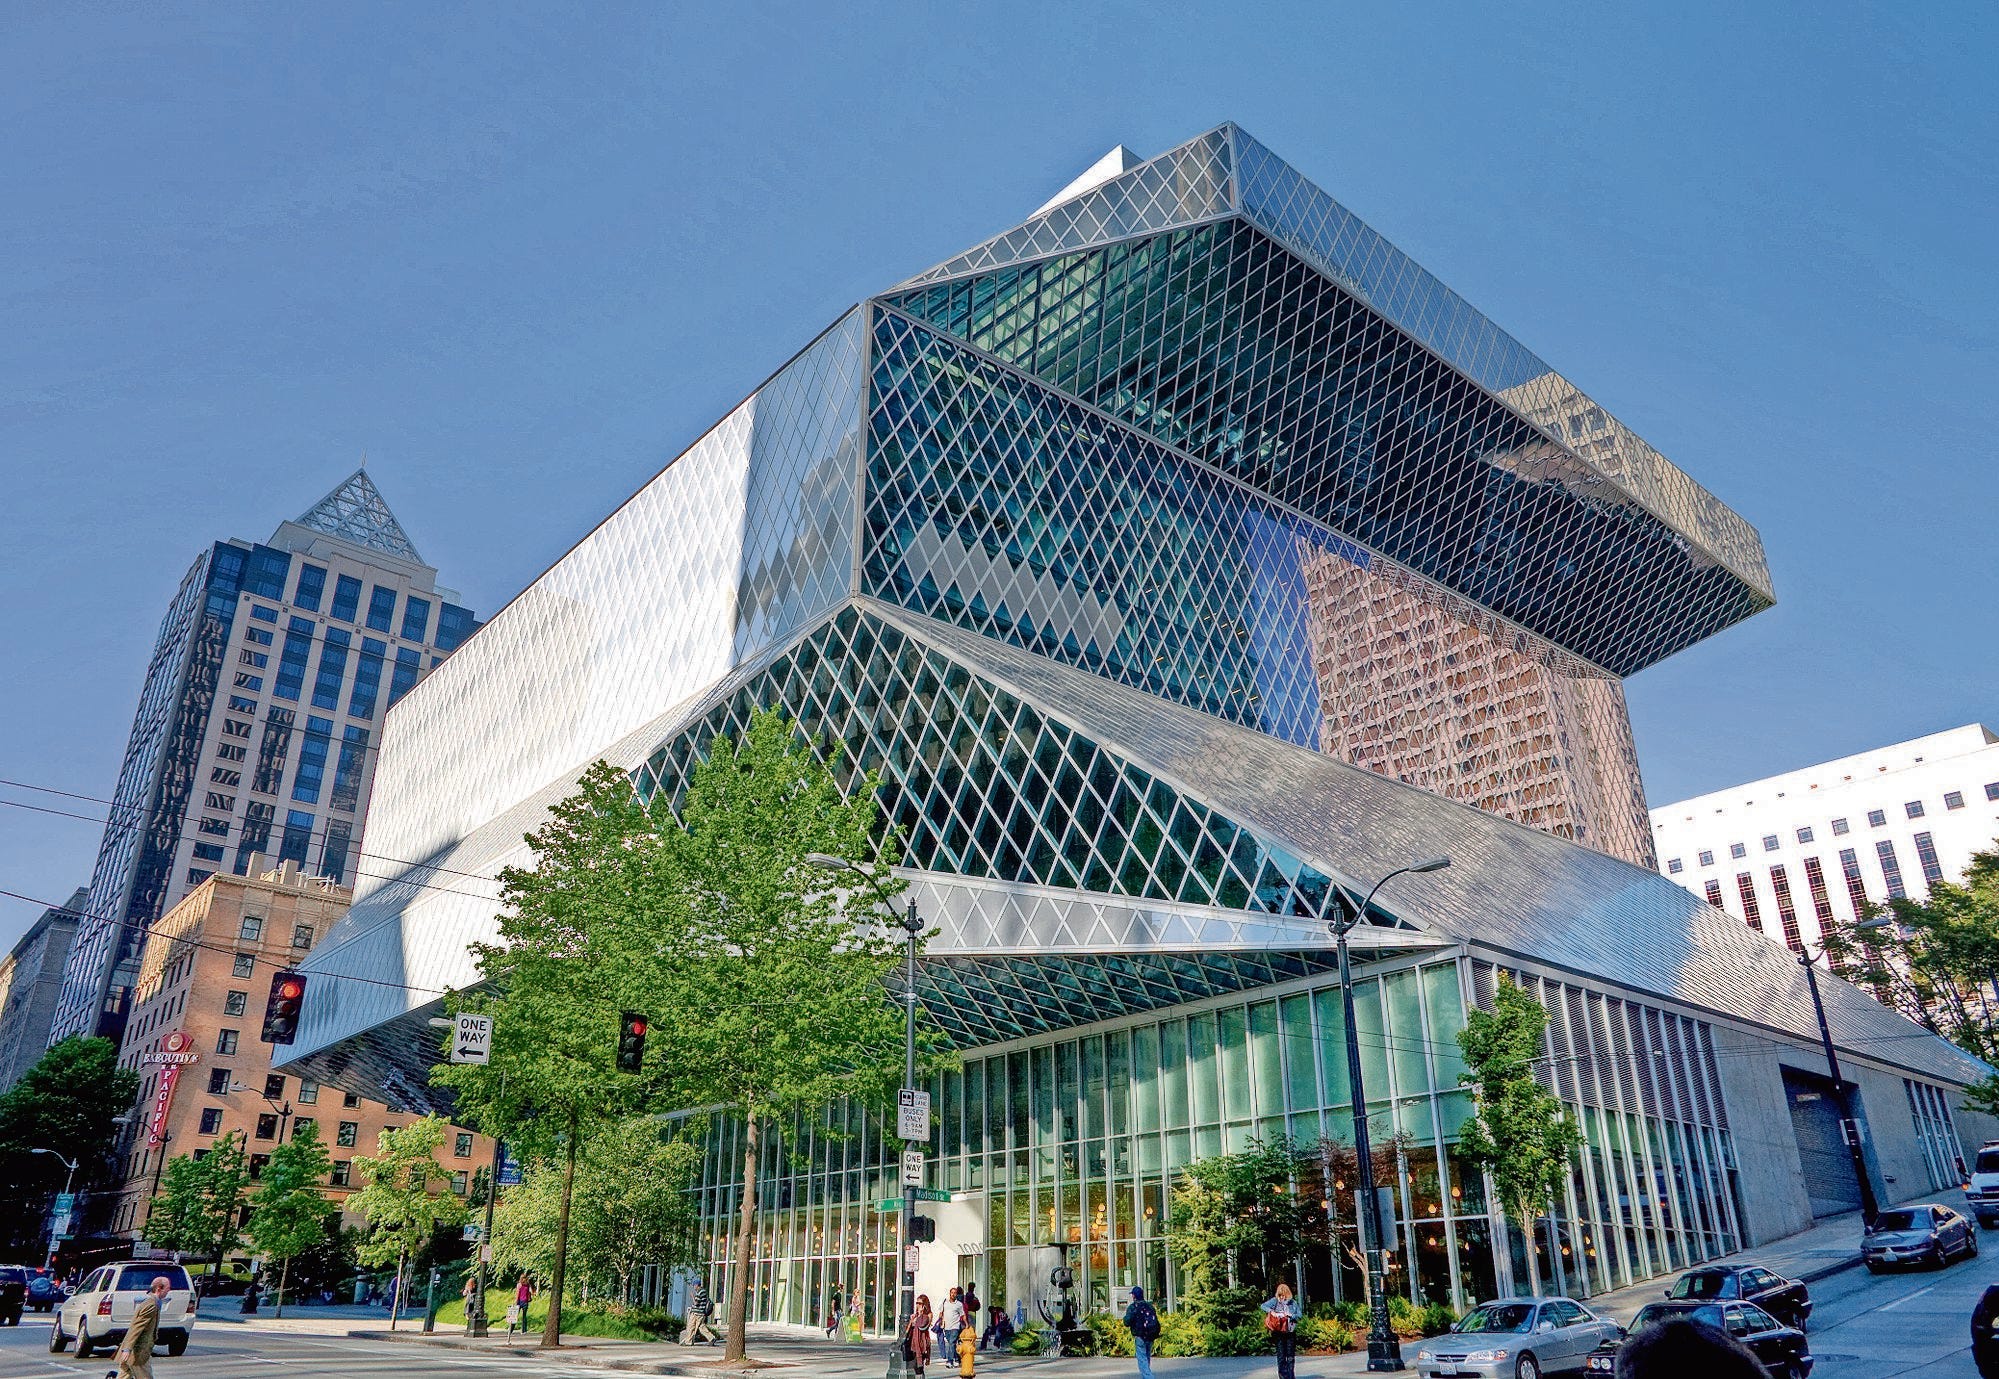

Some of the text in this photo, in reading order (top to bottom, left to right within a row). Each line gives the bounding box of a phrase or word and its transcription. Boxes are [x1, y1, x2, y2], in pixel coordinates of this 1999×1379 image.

[461, 1018, 487, 1031] ONE
[460, 1031, 486, 1043] WAY
[144, 1053, 199, 1063] EXECUTIVE
[149, 1070, 172, 1143] PACIFIC
[903, 1107, 924, 1117] BUSES
[905, 1115, 922, 1123] ONLY
[906, 1154, 921, 1164] ONE
[906, 1163, 922, 1173] WAY
